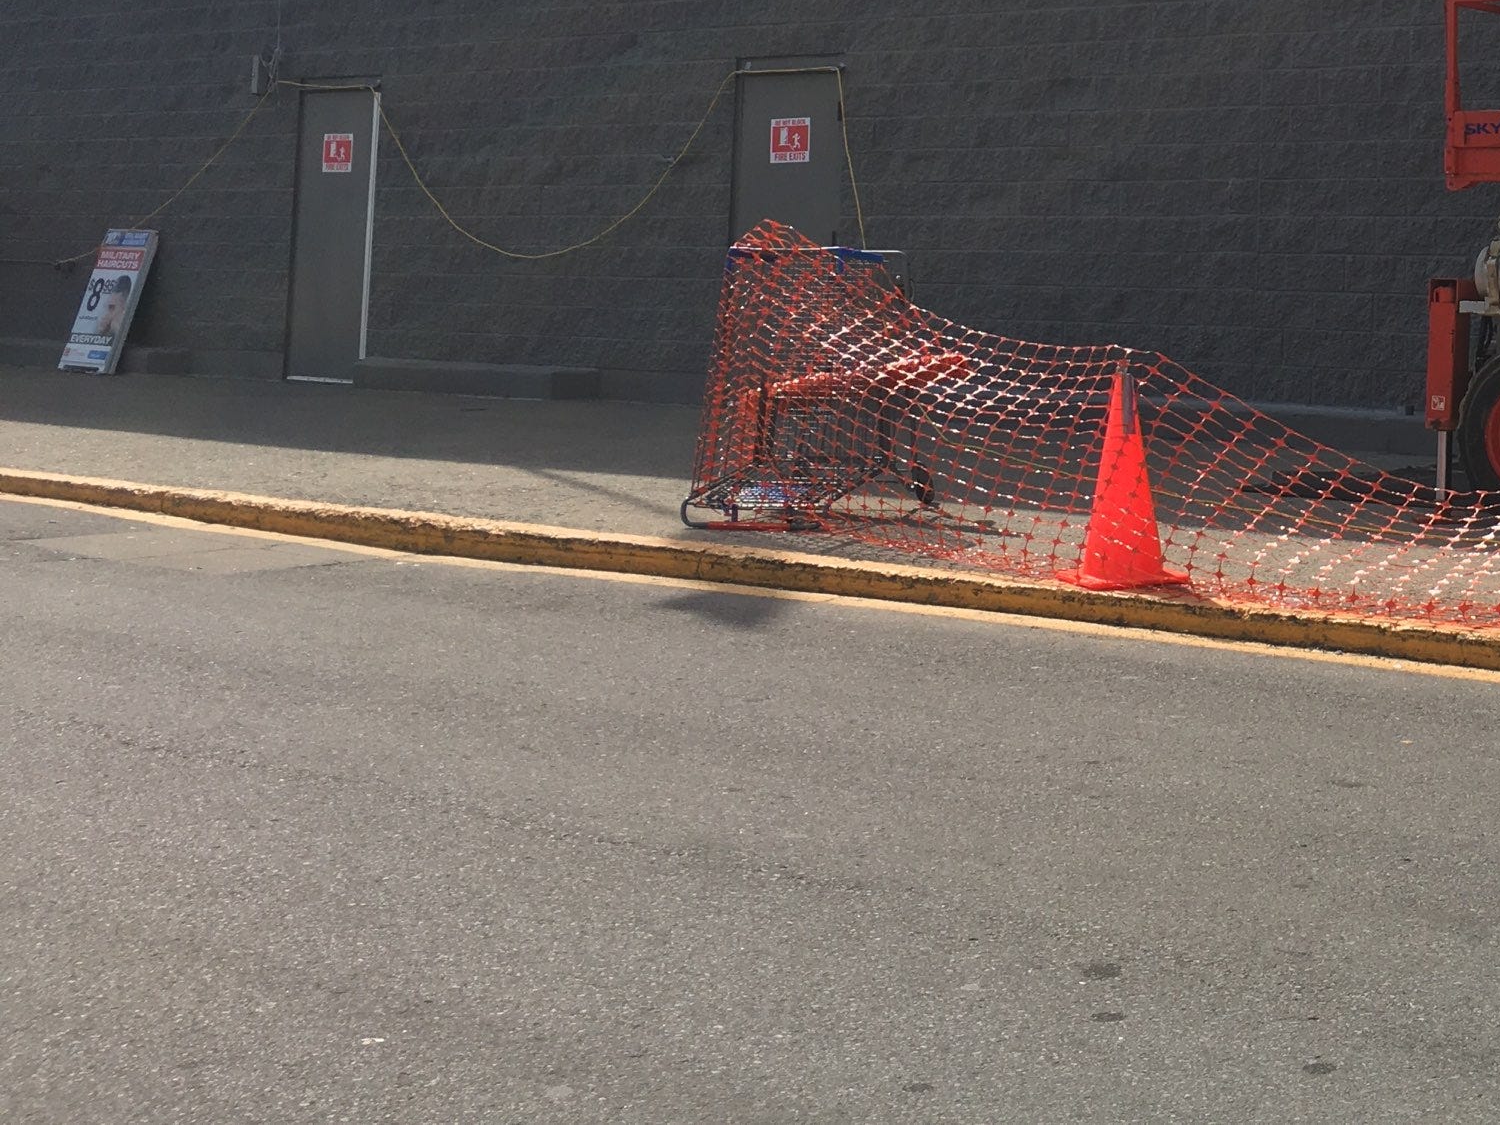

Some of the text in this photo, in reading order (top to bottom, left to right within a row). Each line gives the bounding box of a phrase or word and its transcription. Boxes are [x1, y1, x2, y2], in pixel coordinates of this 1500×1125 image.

[100, 250, 141, 260] MILITARY
[96, 259, 138, 269] HAIRCUTS
[70, 334, 112, 344] EVERYDAY
